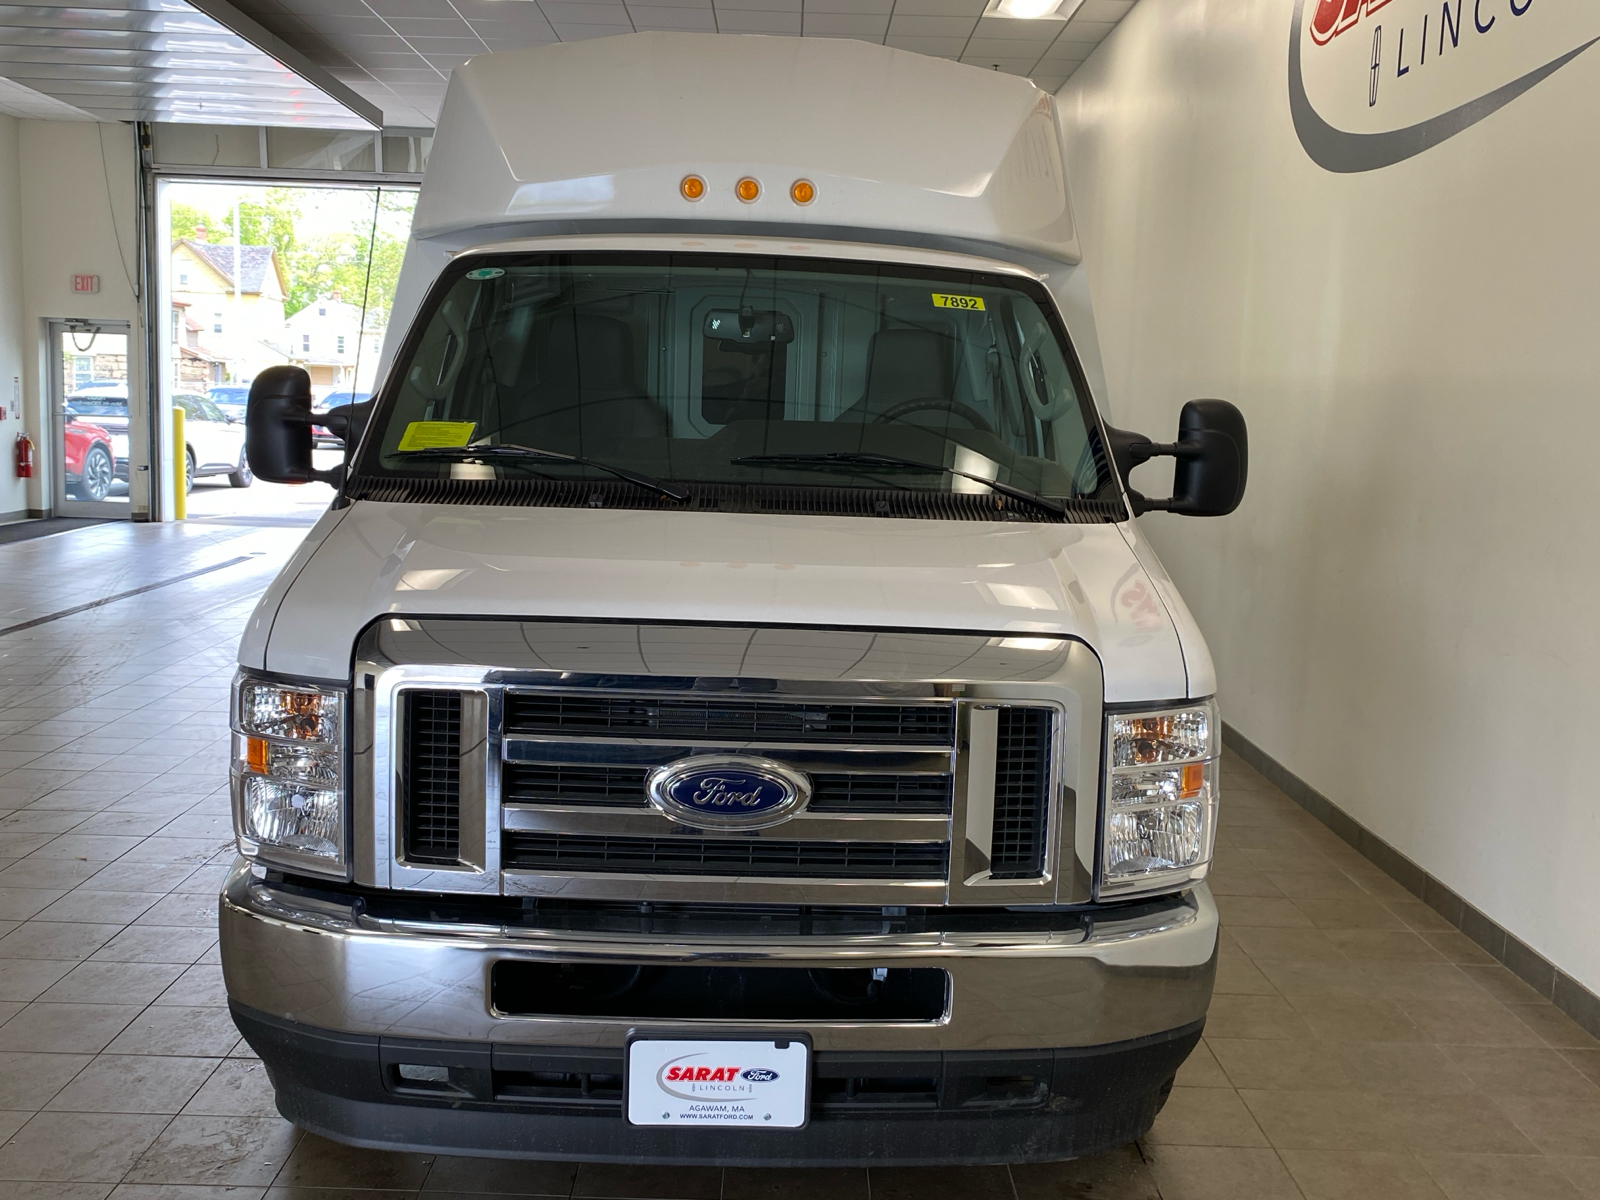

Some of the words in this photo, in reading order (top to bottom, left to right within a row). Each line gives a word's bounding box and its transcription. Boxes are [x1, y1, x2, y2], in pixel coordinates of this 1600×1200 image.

[74, 275, 94, 291] EXIT
[940, 295, 979, 310] 7892
[693, 777, 762, 807] Ford
[665, 1066, 741, 1082] SARAT
[747, 1070, 773, 1082] Ford
[699, 1084, 745, 1092] LINCOLN
[688, 1104, 729, 1113] AGAWAM,
[731, 1105, 745, 1113] MA
